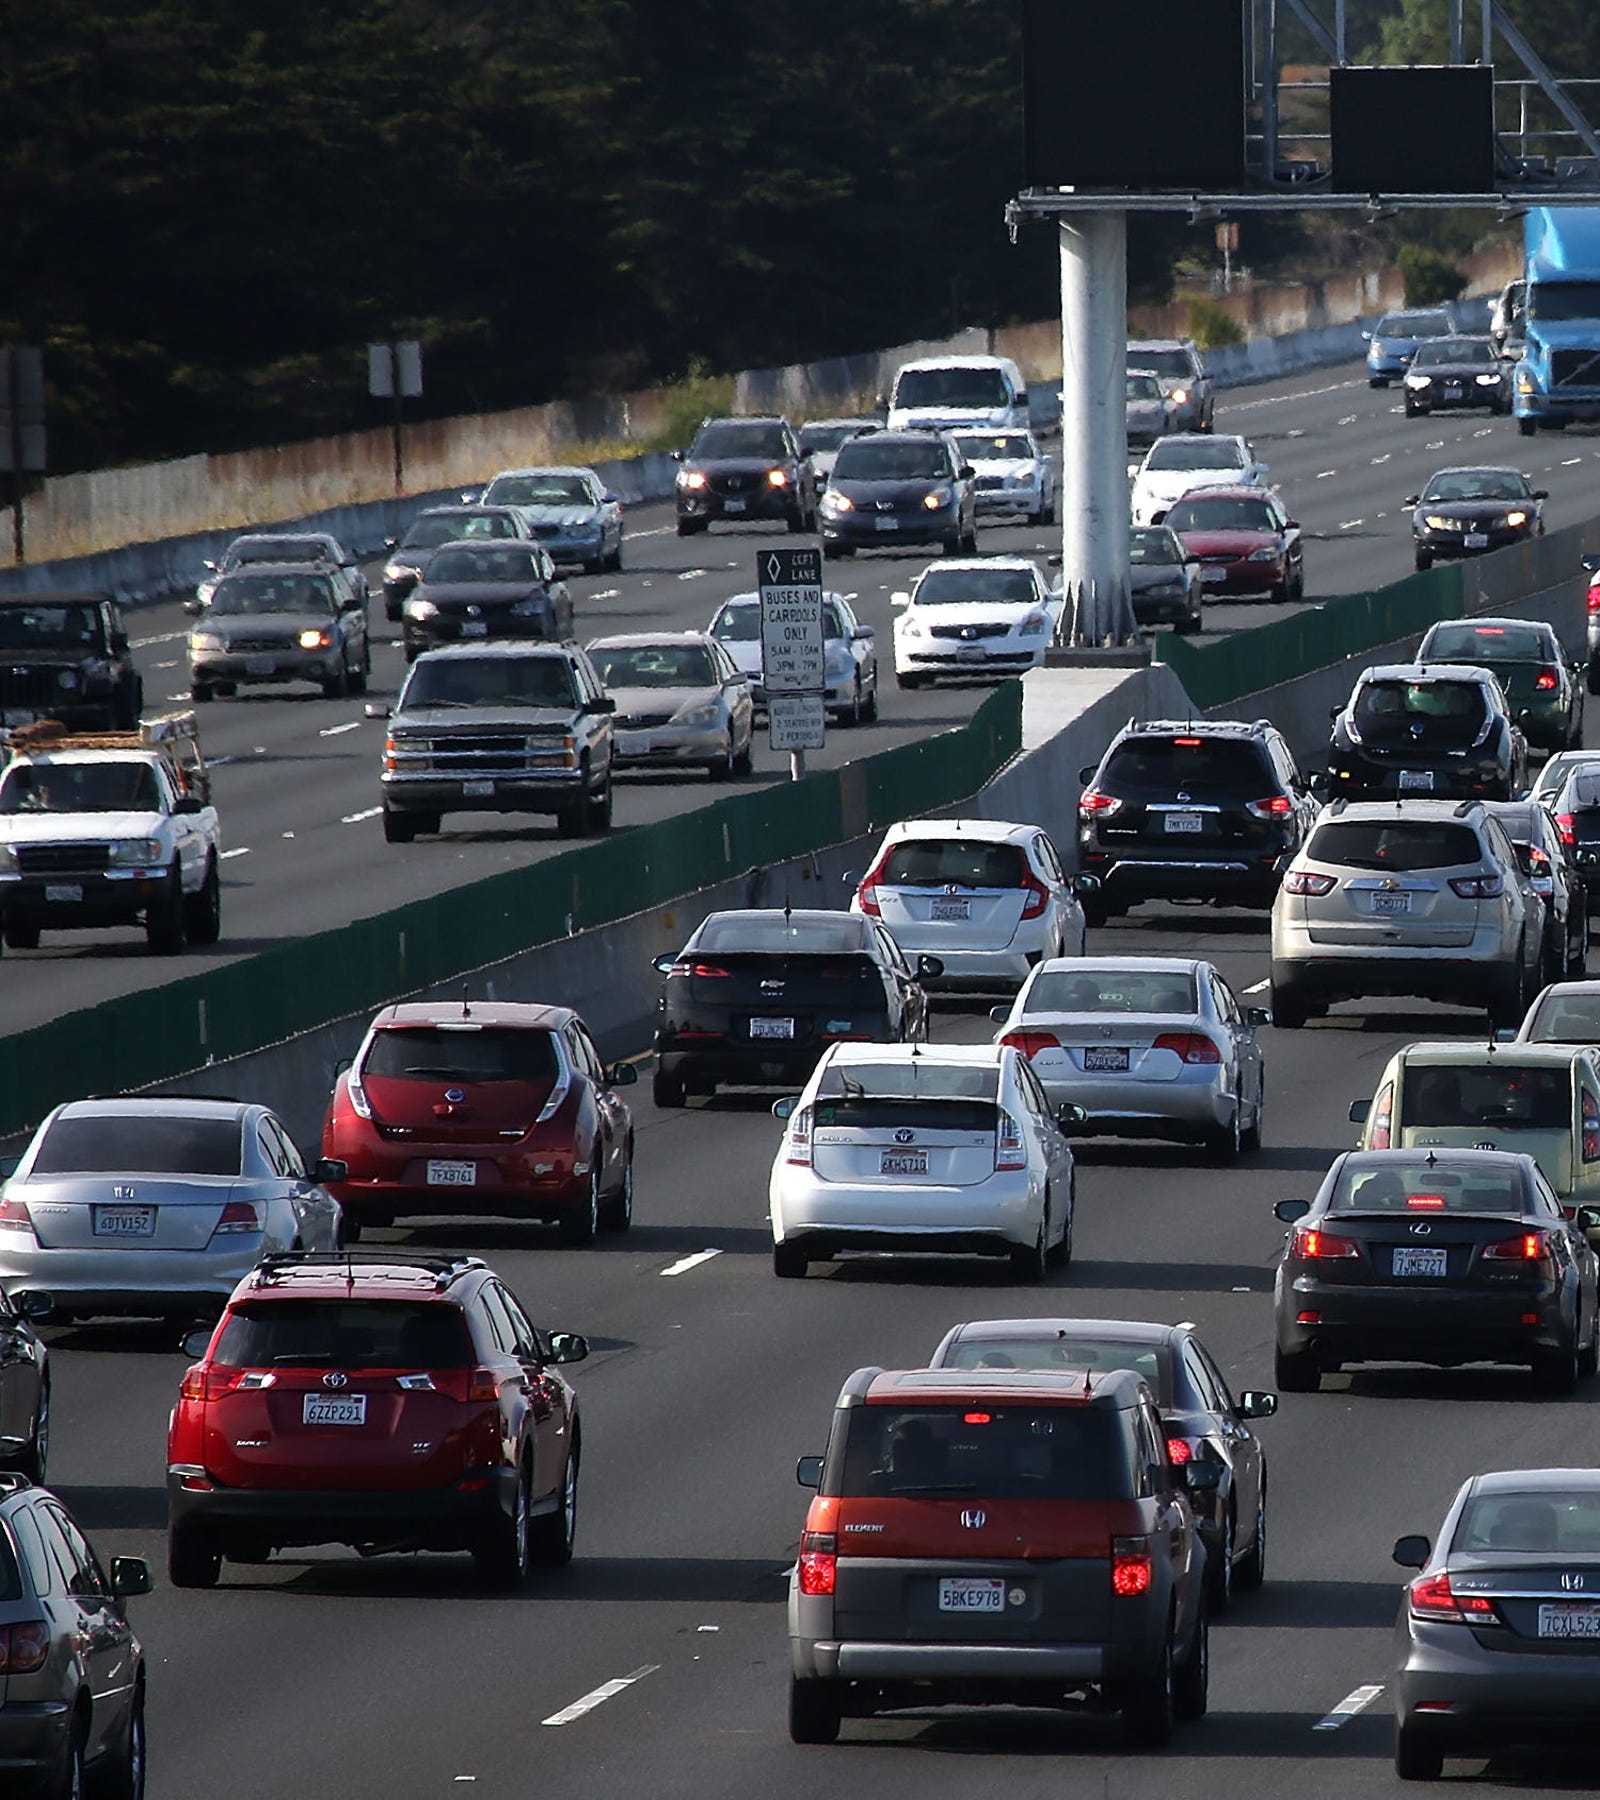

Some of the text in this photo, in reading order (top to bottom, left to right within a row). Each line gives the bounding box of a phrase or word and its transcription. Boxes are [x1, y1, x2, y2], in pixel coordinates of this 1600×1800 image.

[792, 570, 816, 580] LANE
[767, 591, 818, 604] BUSES AND
[769, 609, 817, 622] CARPOOLS
[784, 627, 807, 640] ONLY
[1397, 1258, 1443, 1271] 7JME727
[309, 1405, 361, 1420] 6ZZP291
[845, 1524, 884, 1532] ELEMENT
[943, 1590, 1000, 1607] 5BKE978
[1545, 1616, 1600, 1632] 7CXL523
